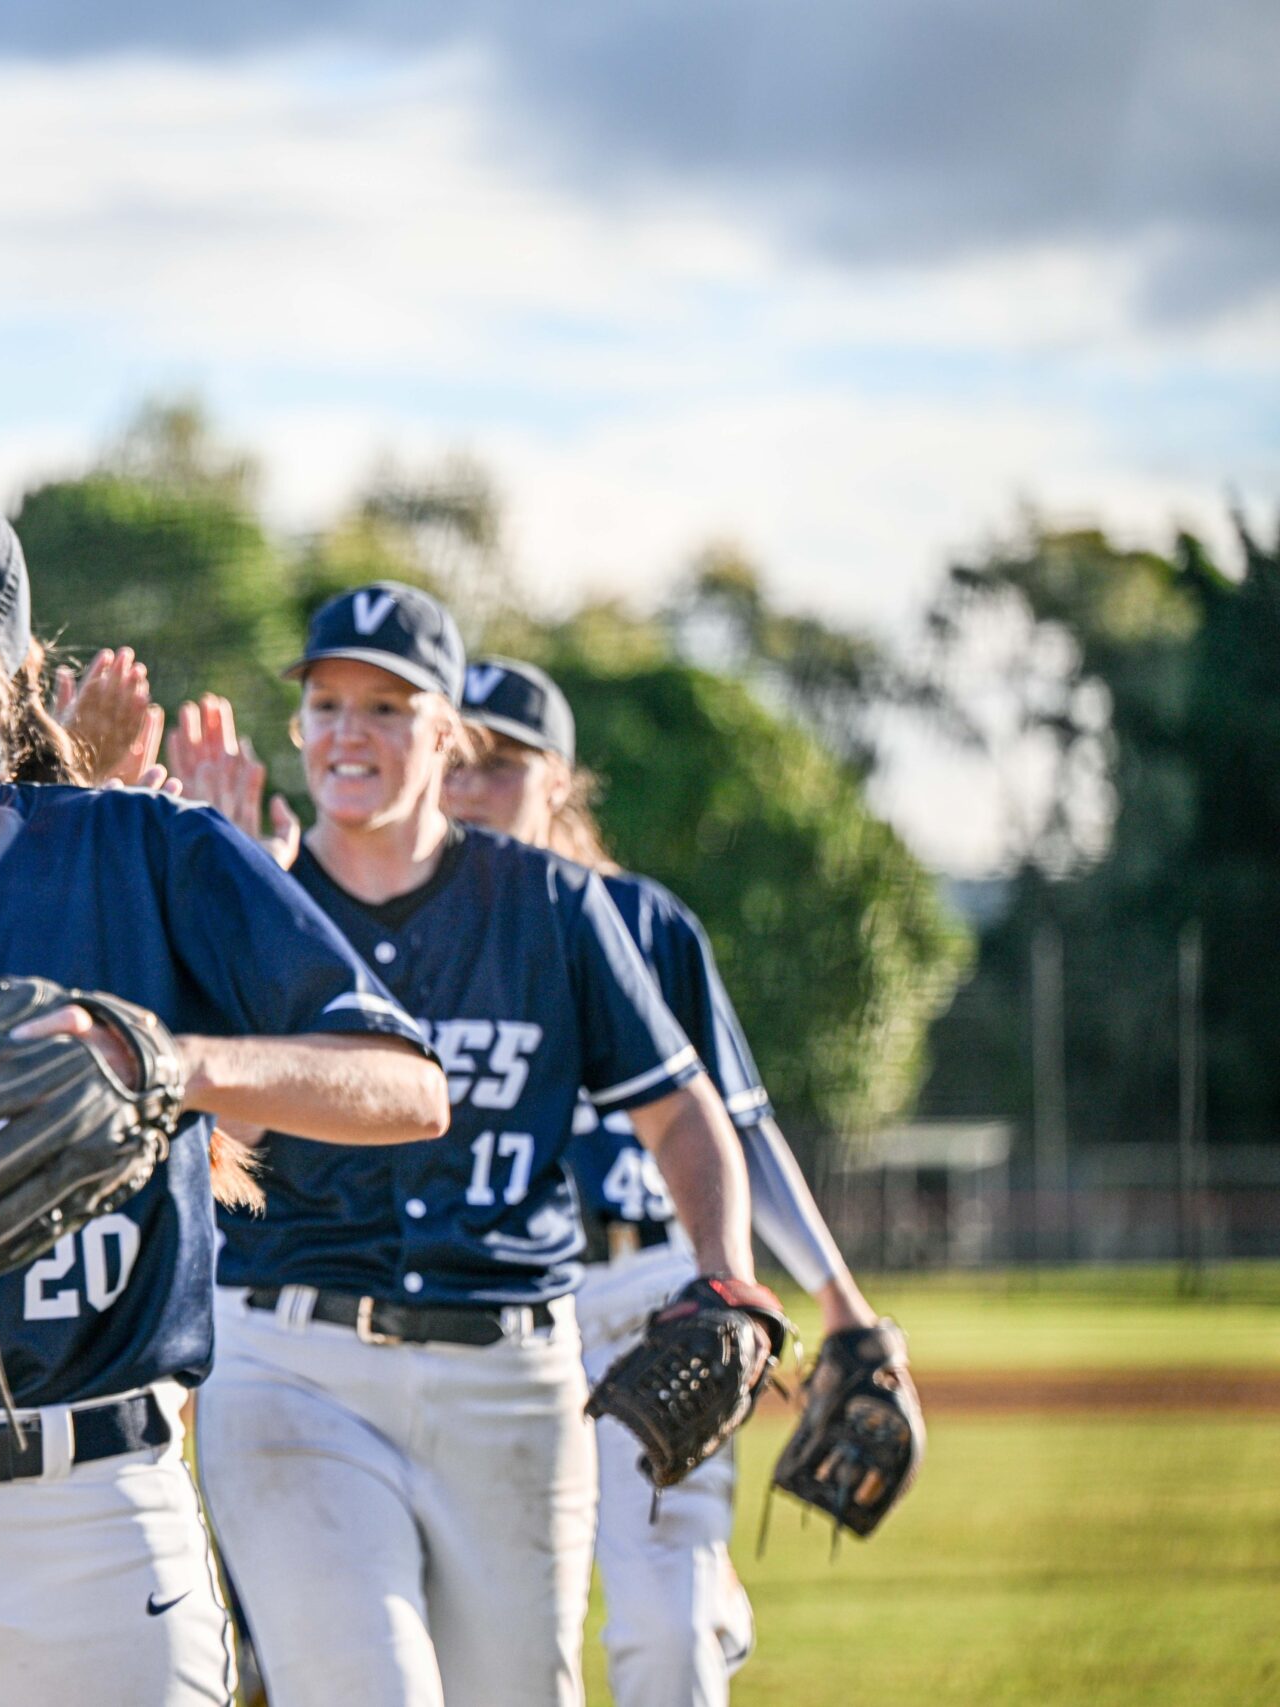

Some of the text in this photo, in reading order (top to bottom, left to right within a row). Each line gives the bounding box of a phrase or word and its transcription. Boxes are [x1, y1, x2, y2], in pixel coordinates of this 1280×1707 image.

[353, 592, 396, 635] V
[464, 664, 507, 703] V
[420, 1018, 543, 1110] ES
[466, 1130, 534, 1206] 17
[23, 1212, 140, 1320] 20
